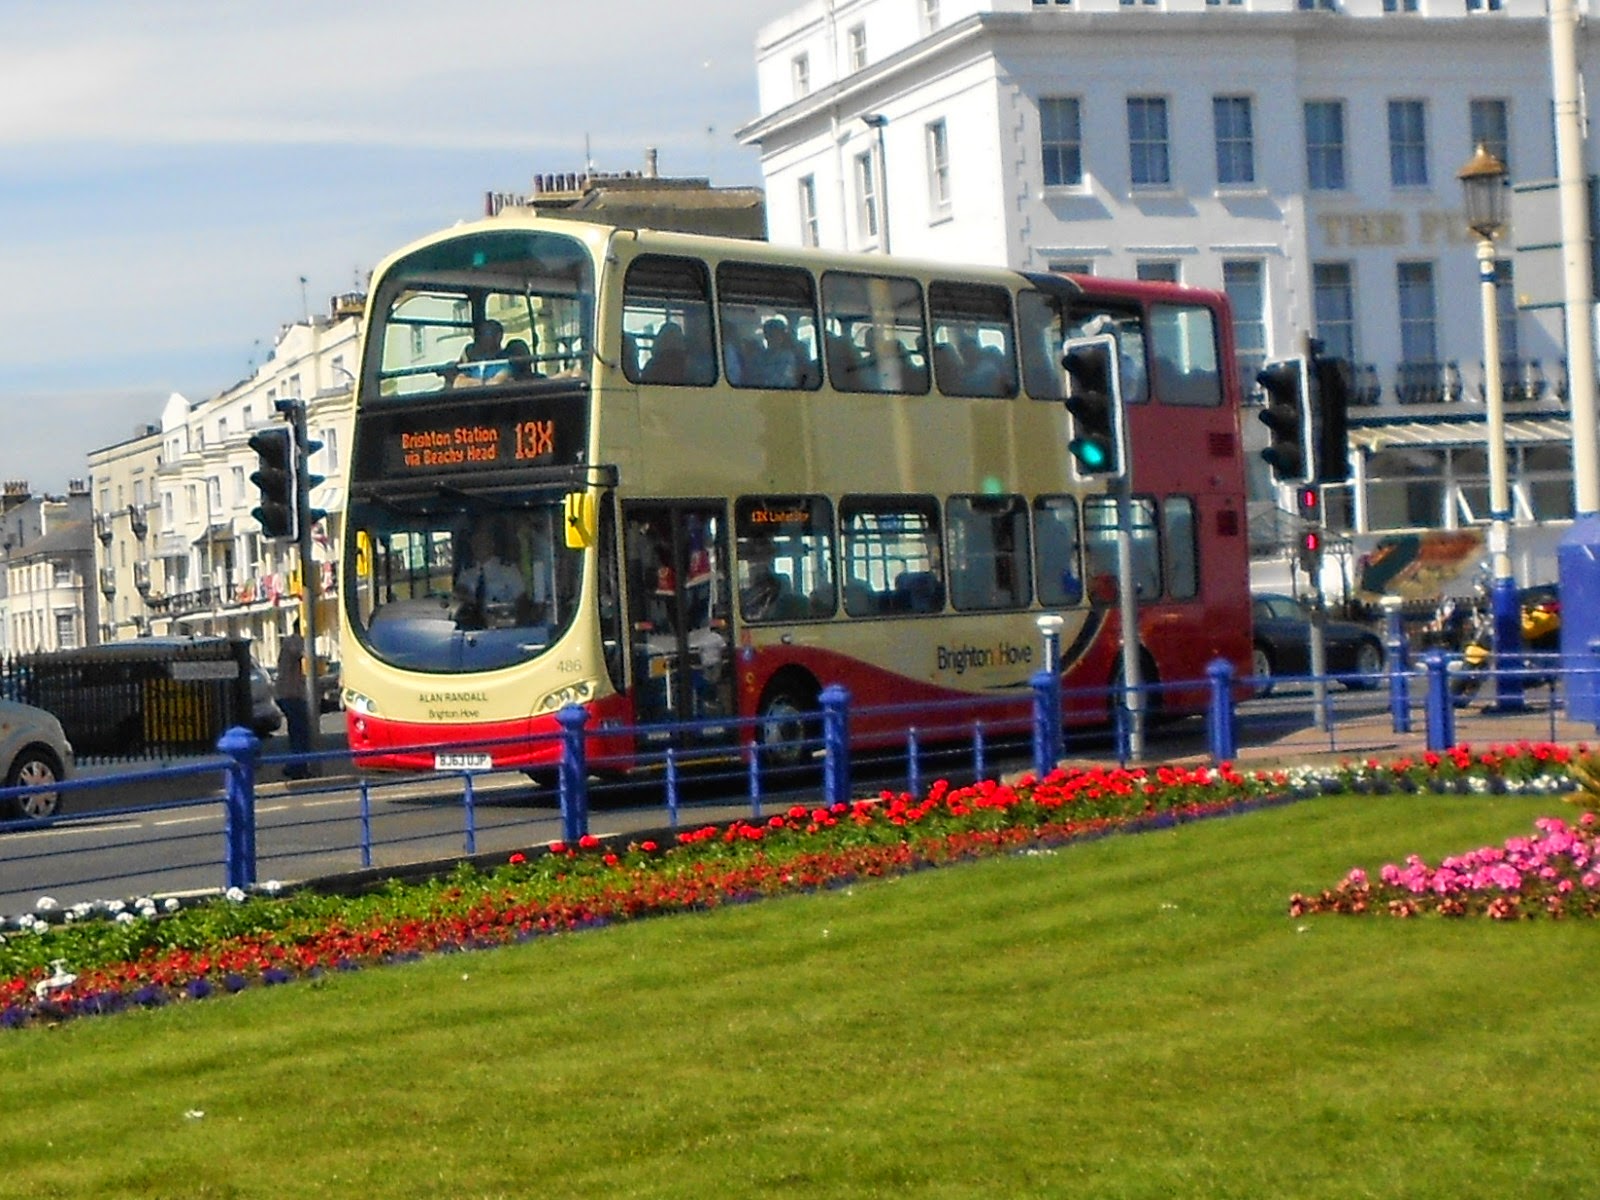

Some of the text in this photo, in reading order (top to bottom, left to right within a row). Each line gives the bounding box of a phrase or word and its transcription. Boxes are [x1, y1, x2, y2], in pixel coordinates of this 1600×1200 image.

[402, 426, 498, 449] Brighton Station
[514, 420, 554, 459] 13X
[404, 444, 496, 466] via Beachy Head
[557, 659, 582, 673] 486
[938, 641, 1032, 674] Brighton Hove
[419, 691, 488, 703] ALAN RANDALL
[429, 708, 480, 721] Brighton Hove
[440, 754, 487, 766] BJ63 UJP
